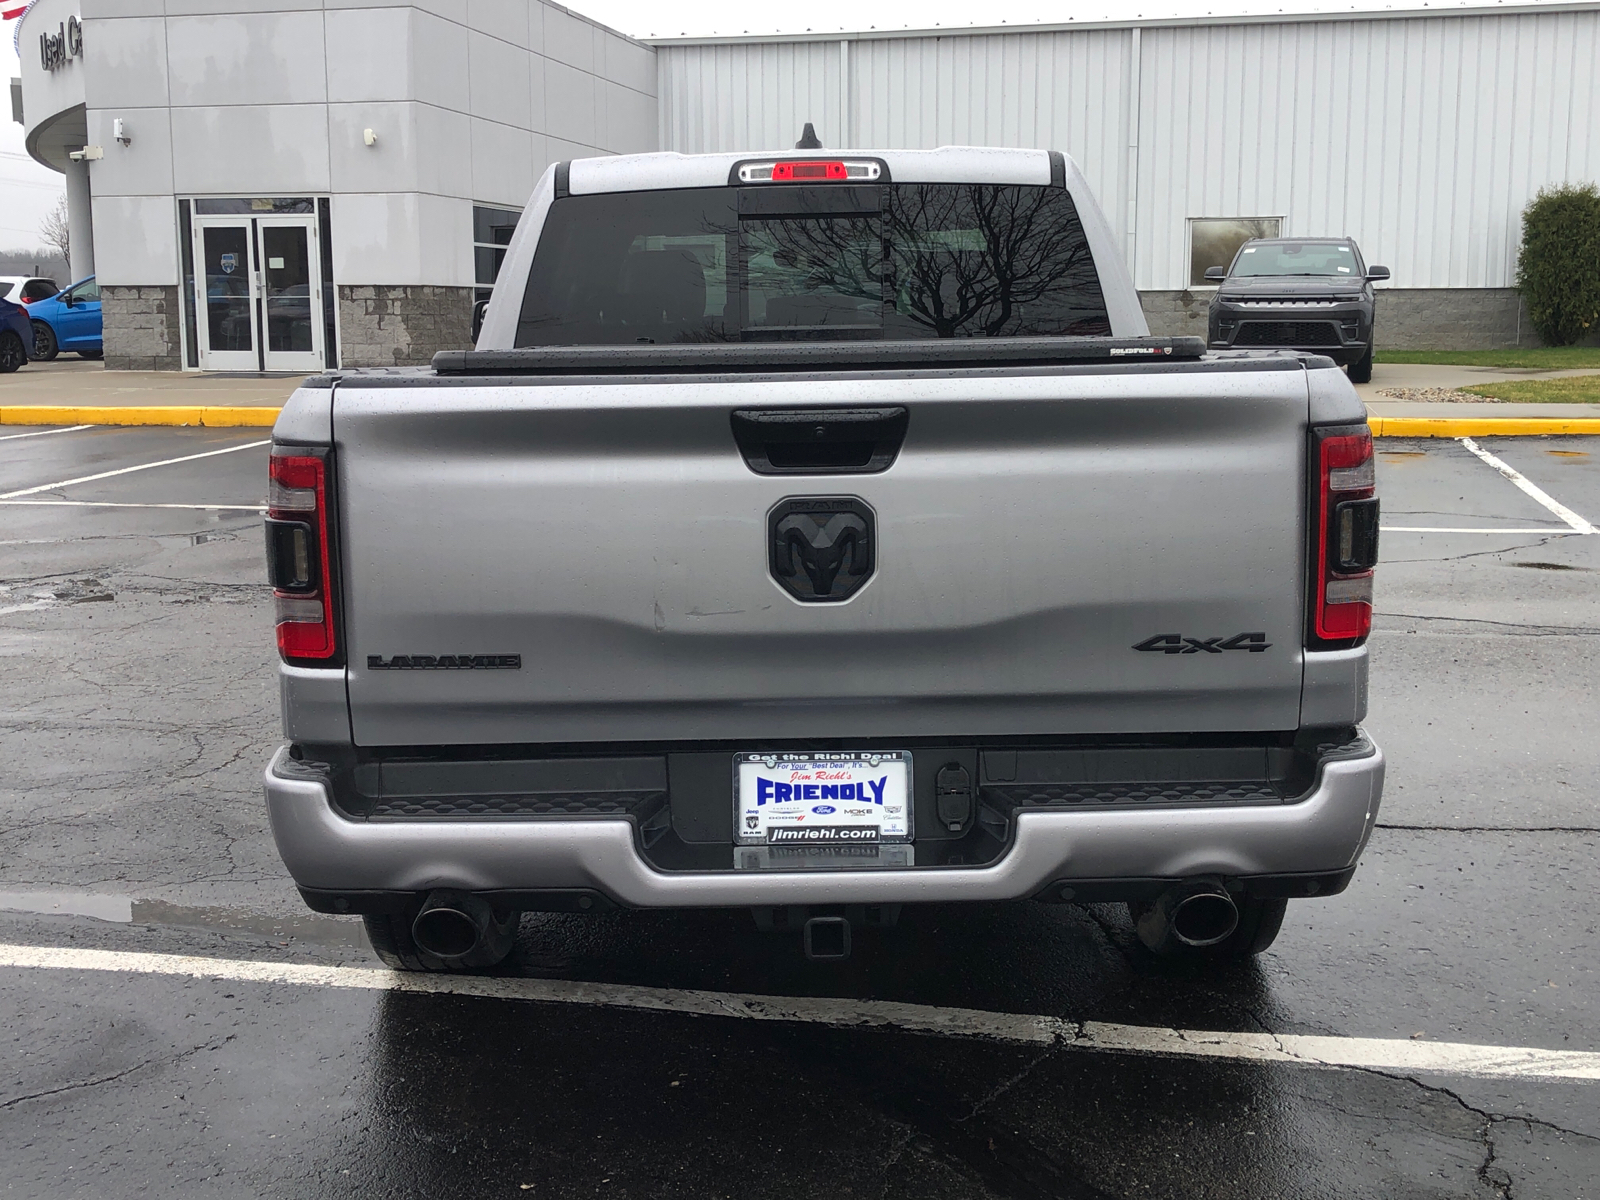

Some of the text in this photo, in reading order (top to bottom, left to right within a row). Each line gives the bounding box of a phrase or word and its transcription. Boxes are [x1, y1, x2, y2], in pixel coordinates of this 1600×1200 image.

[40, 22, 66, 71] Used
[789, 501, 853, 511] RAM
[1131, 632, 1273, 654] 4x4
[367, 654, 521, 670] LARAMIE
[782, 753, 809, 761] the
[790, 771, 852, 783] Jim Riehl's
[757, 775, 888, 806] FRIENDLY
[771, 829, 876, 842] jimriehl.com
